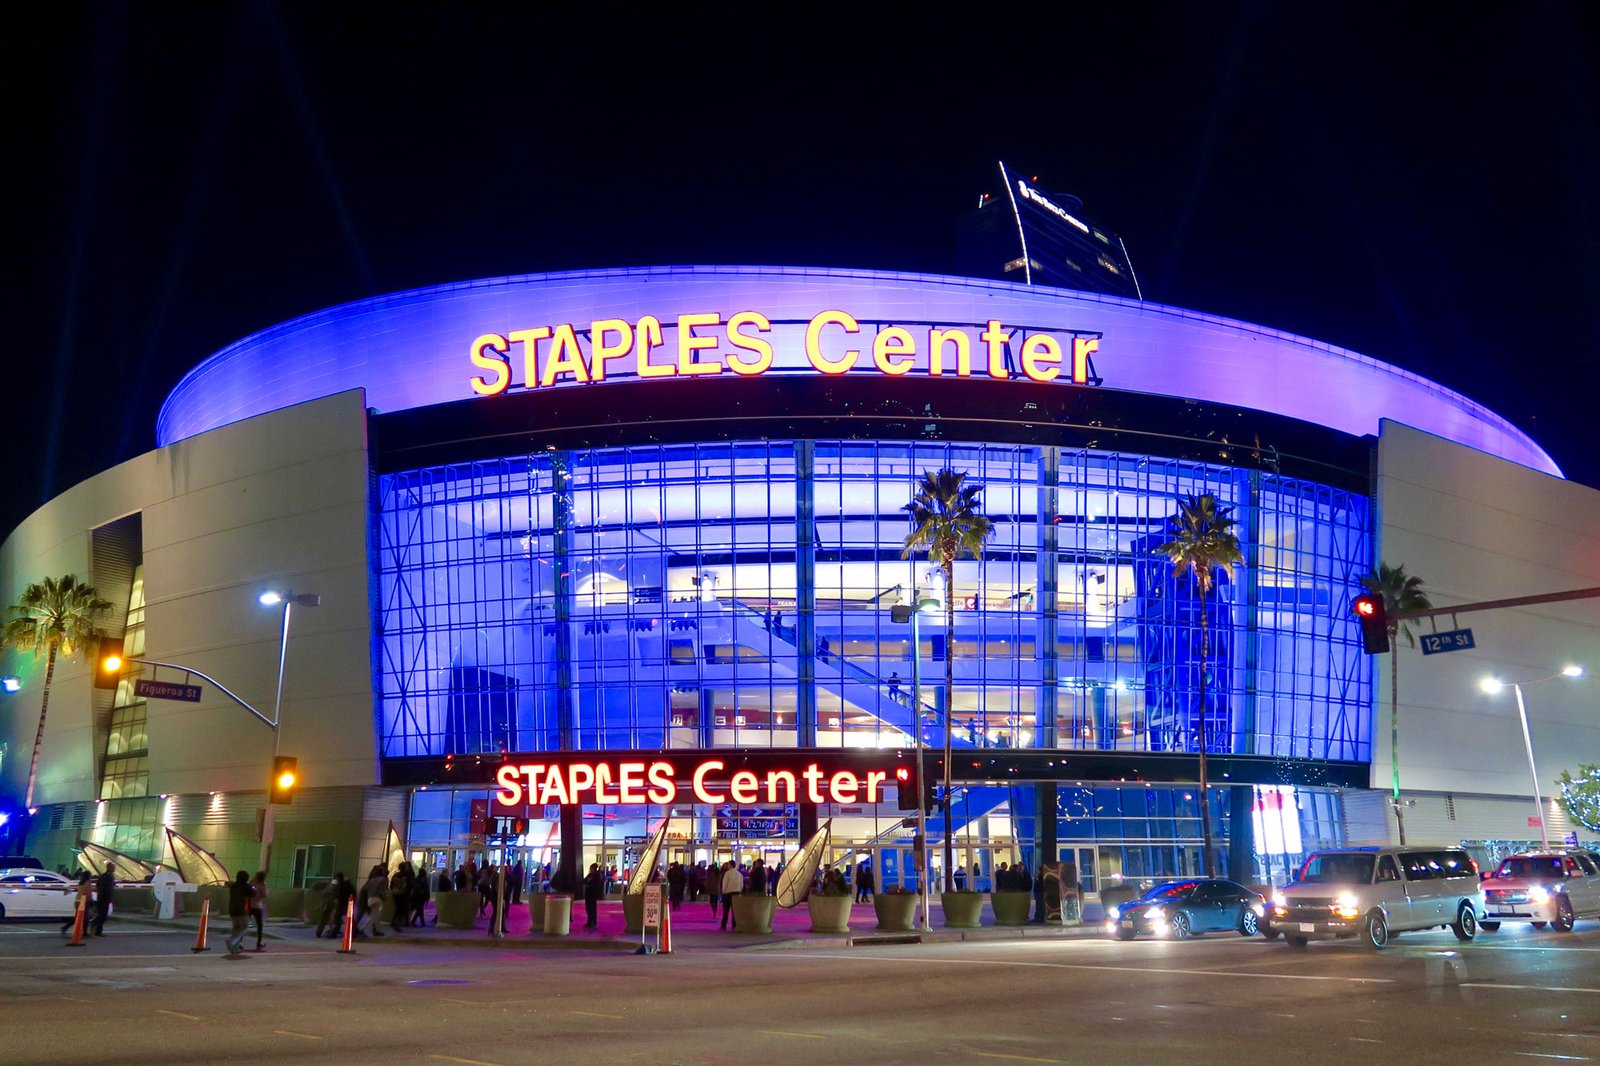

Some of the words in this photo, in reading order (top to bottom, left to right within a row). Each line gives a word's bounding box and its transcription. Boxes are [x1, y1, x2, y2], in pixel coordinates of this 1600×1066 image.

[469, 311, 772, 396] STAPLES
[805, 310, 1100, 384] Center
[1426, 635, 1451, 651] 12th
[1455, 634, 1470, 646] St
[140, 684, 182, 696] Figueroa
[186, 688, 197, 698] St
[496, 762, 676, 807] STAPLES
[692, 760, 887, 805] Center
